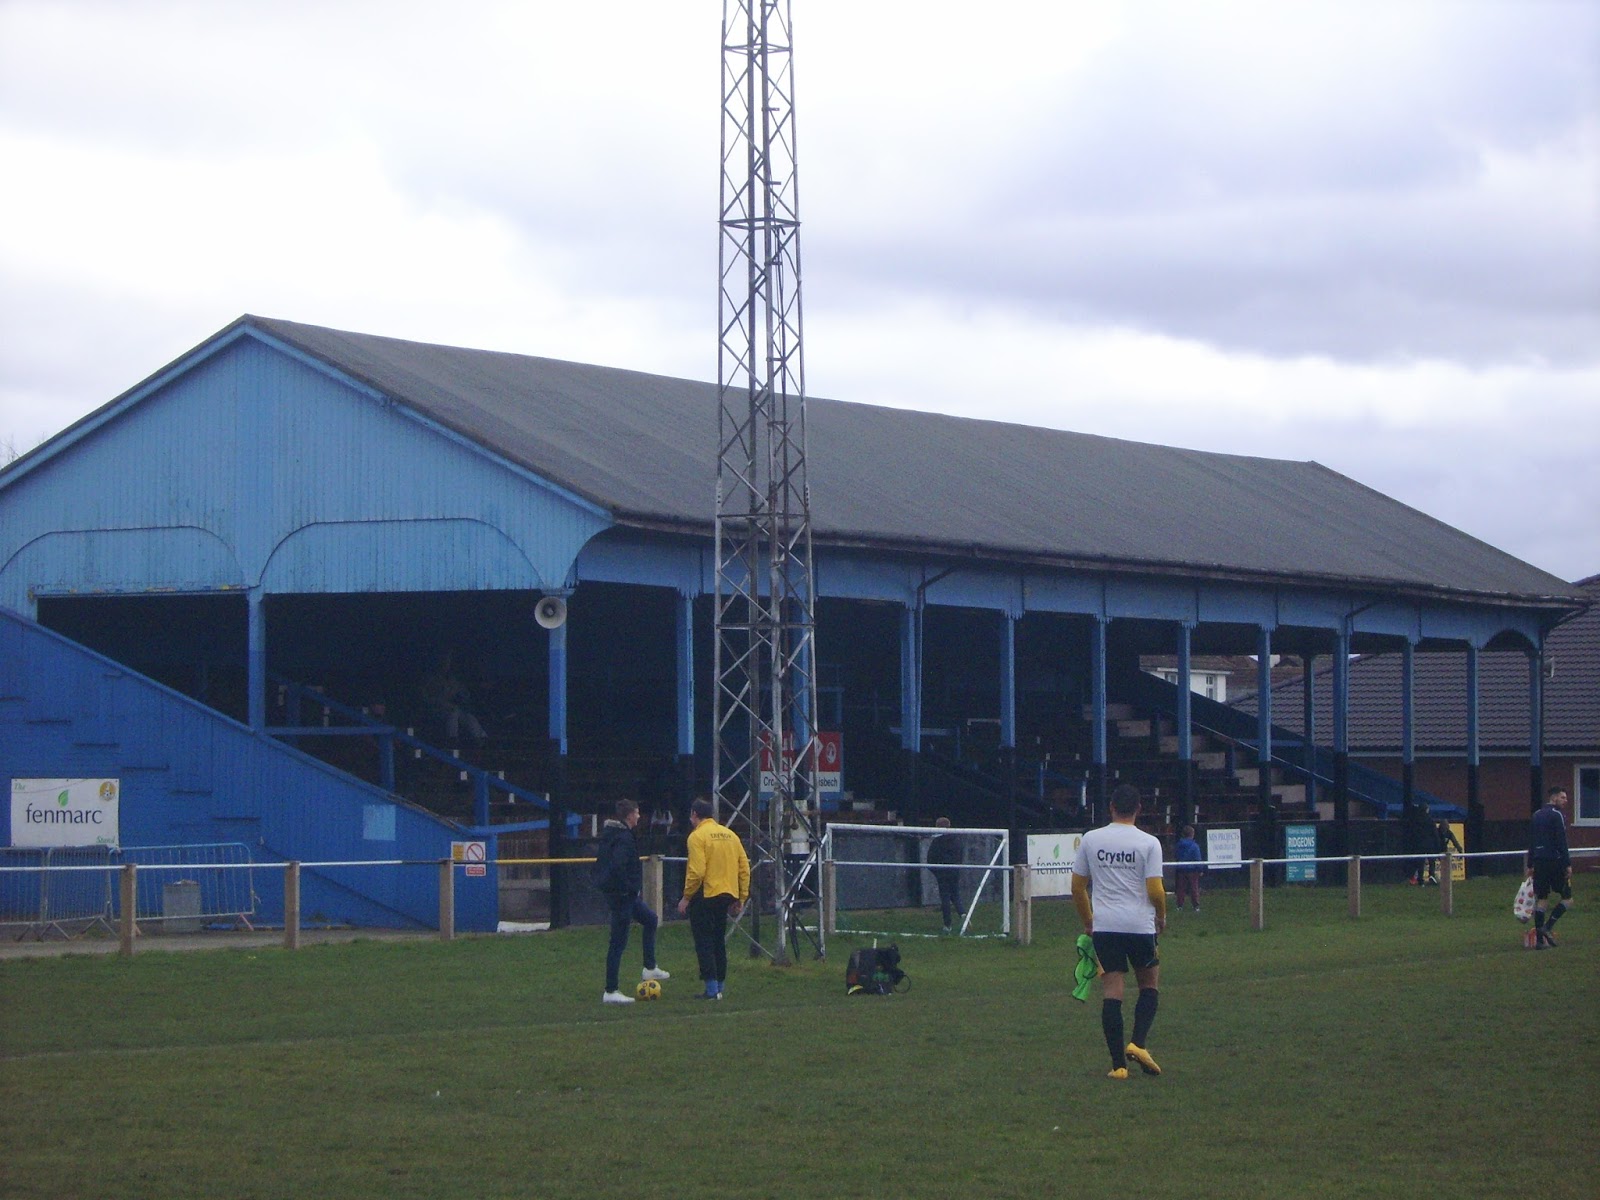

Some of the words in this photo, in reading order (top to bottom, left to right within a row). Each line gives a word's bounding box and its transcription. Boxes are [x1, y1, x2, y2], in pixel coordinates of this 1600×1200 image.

[26, 803, 103, 824] fenmarc
[1288, 836, 1315, 847] RIDGEONS
[1097, 849, 1136, 864] Crystal
